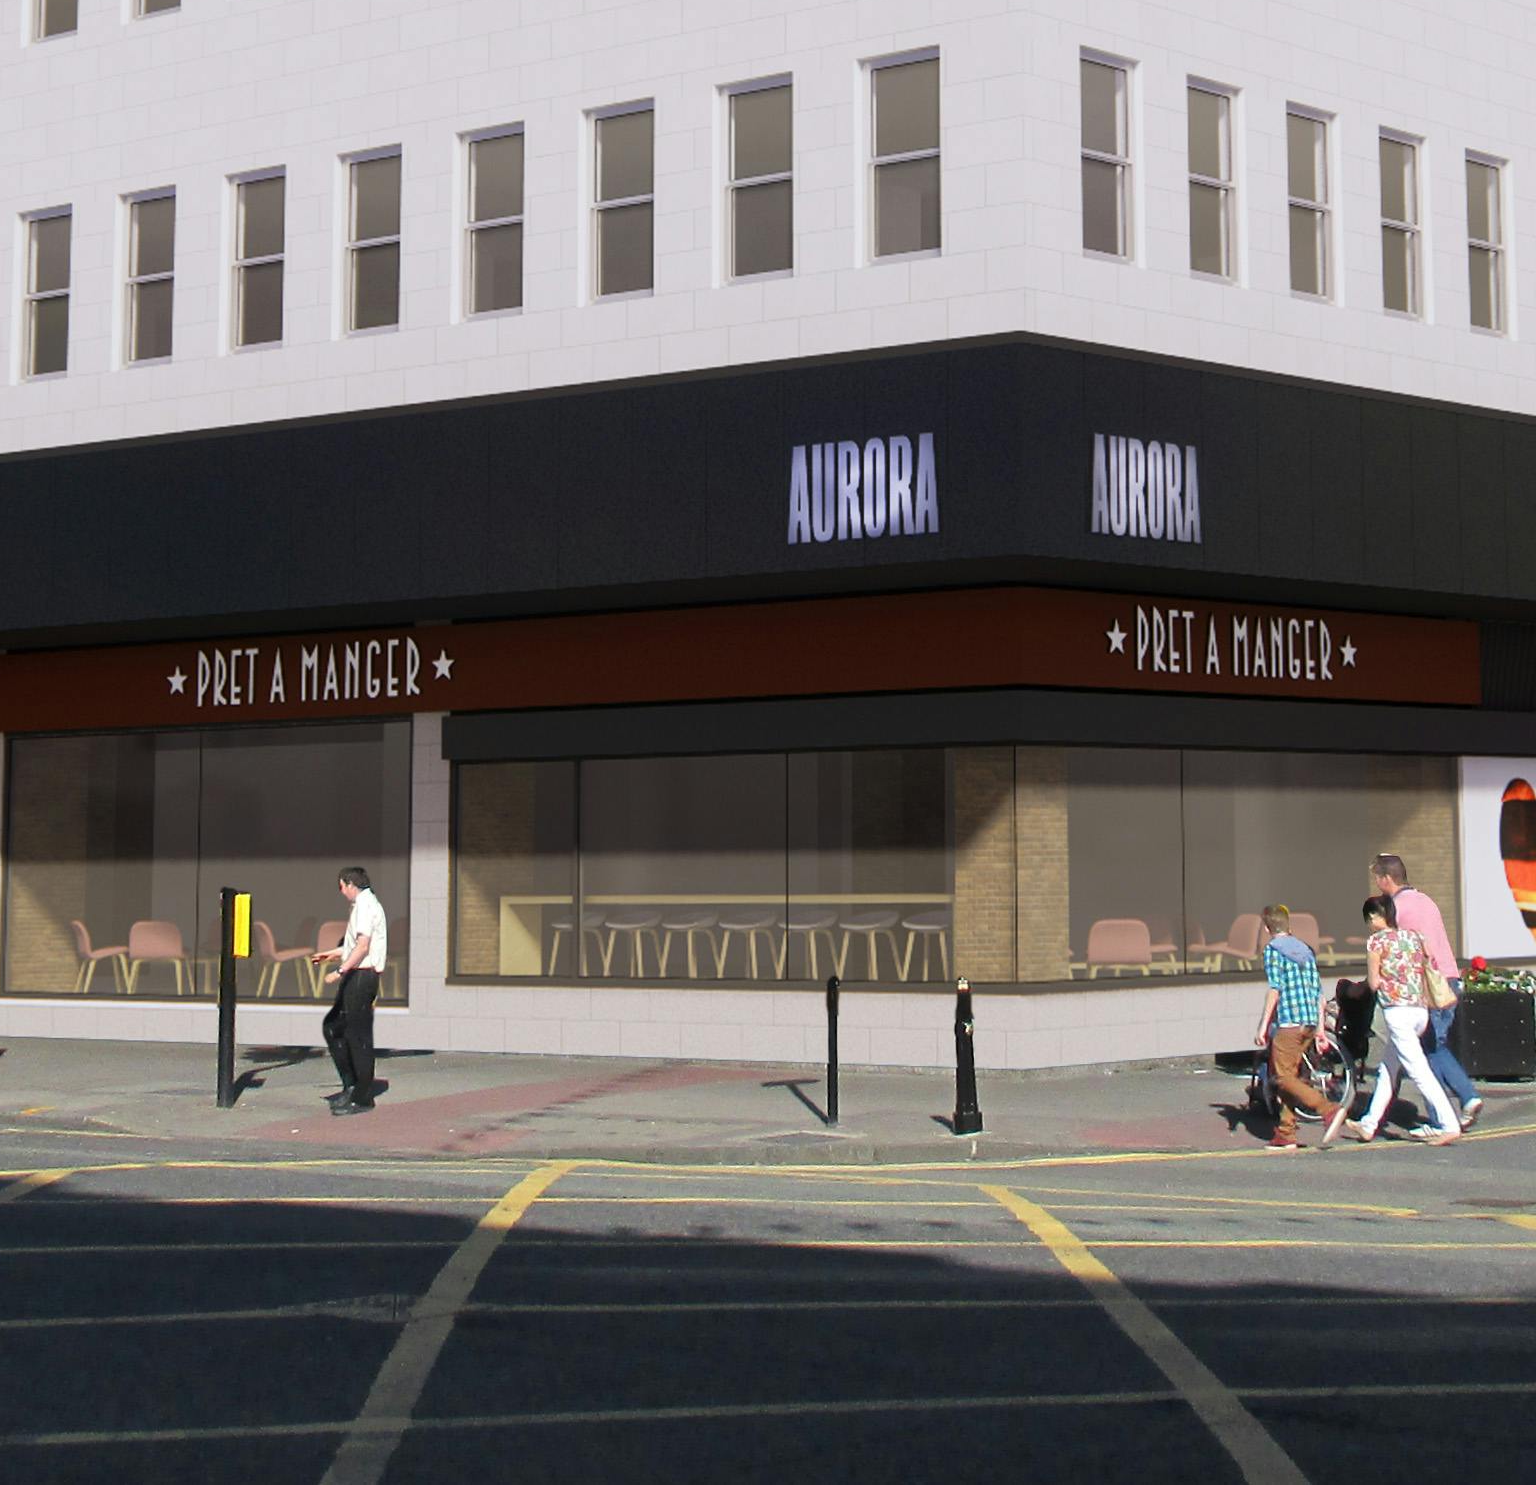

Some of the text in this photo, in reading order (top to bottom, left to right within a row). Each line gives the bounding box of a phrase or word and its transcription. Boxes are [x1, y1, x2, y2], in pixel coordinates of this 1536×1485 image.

[787, 432, 939, 544] AURORA
[1091, 433, 1202, 543] AURORA
[196, 636, 421, 707] PRET A MANGER
[1136, 604, 1333, 680] PRET A MANGER
